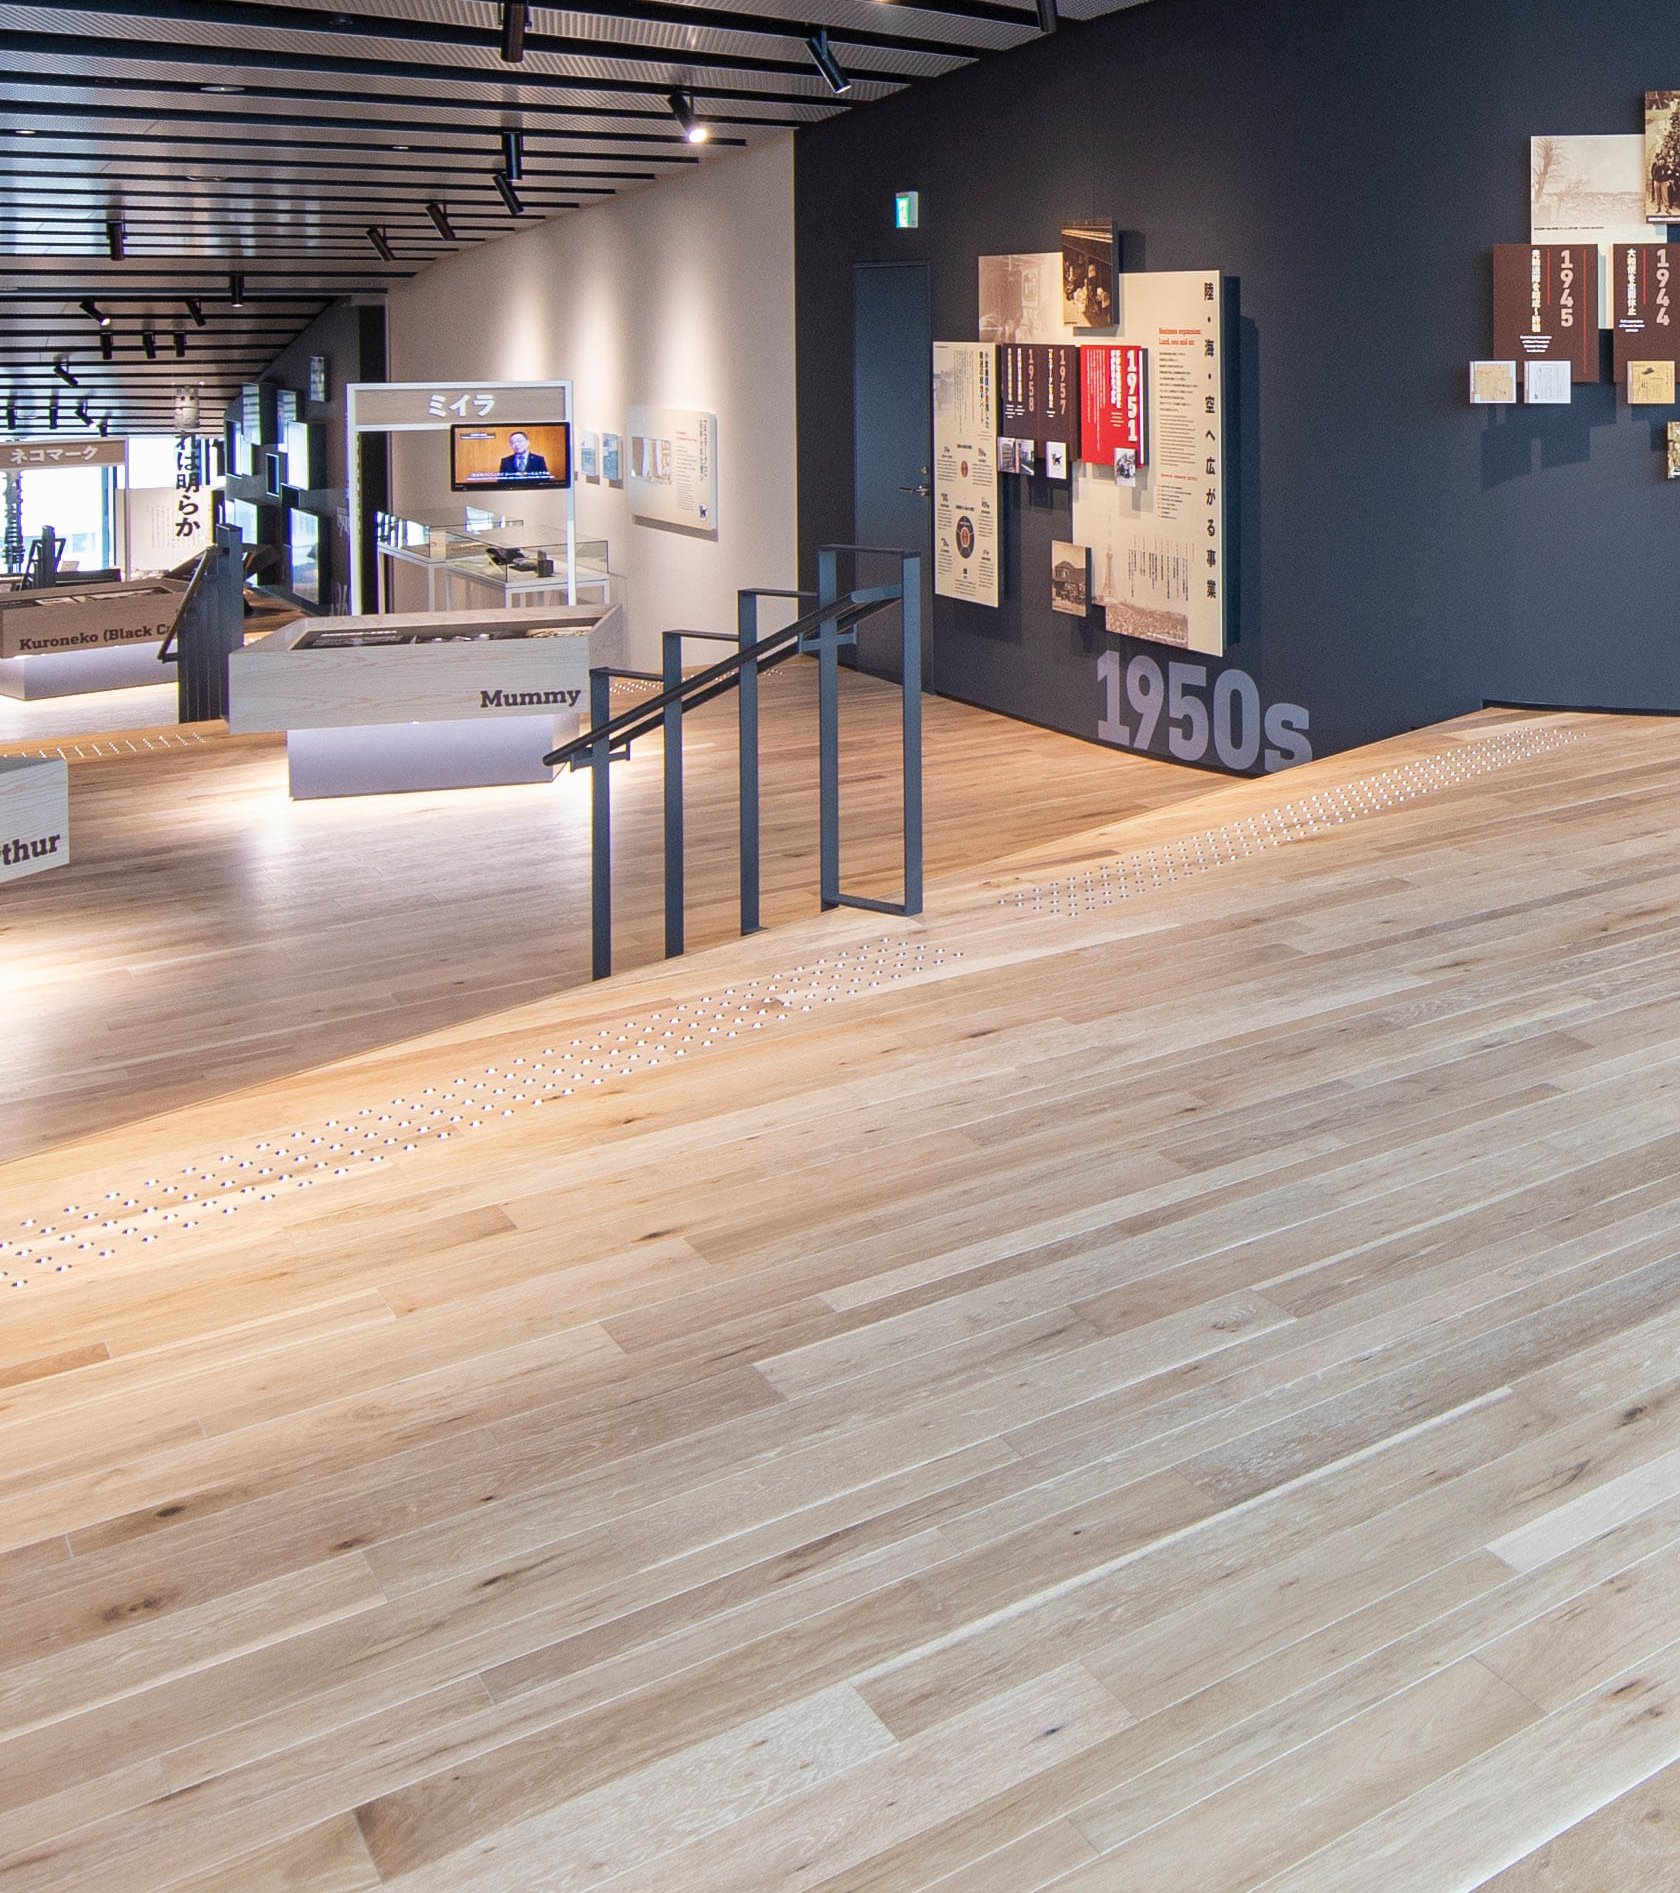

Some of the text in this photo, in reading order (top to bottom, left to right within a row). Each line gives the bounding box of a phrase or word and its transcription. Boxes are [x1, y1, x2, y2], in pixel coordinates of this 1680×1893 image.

[1560, 249, 1574, 327] 1945
[1656, 249, 1670, 326] 1944
[427, 393, 496, 418] ミイラ
[1059, 349, 1067, 415] 1957
[1126, 349, 1138, 442] 1951
[10, 445, 98, 464] ネコマーク
[19, 632, 99, 651] Kuroneko
[103, 625, 152, 643] (Black
[480, 688, 582, 710] Mummy
[1096, 649, 1313, 773] 1950s
